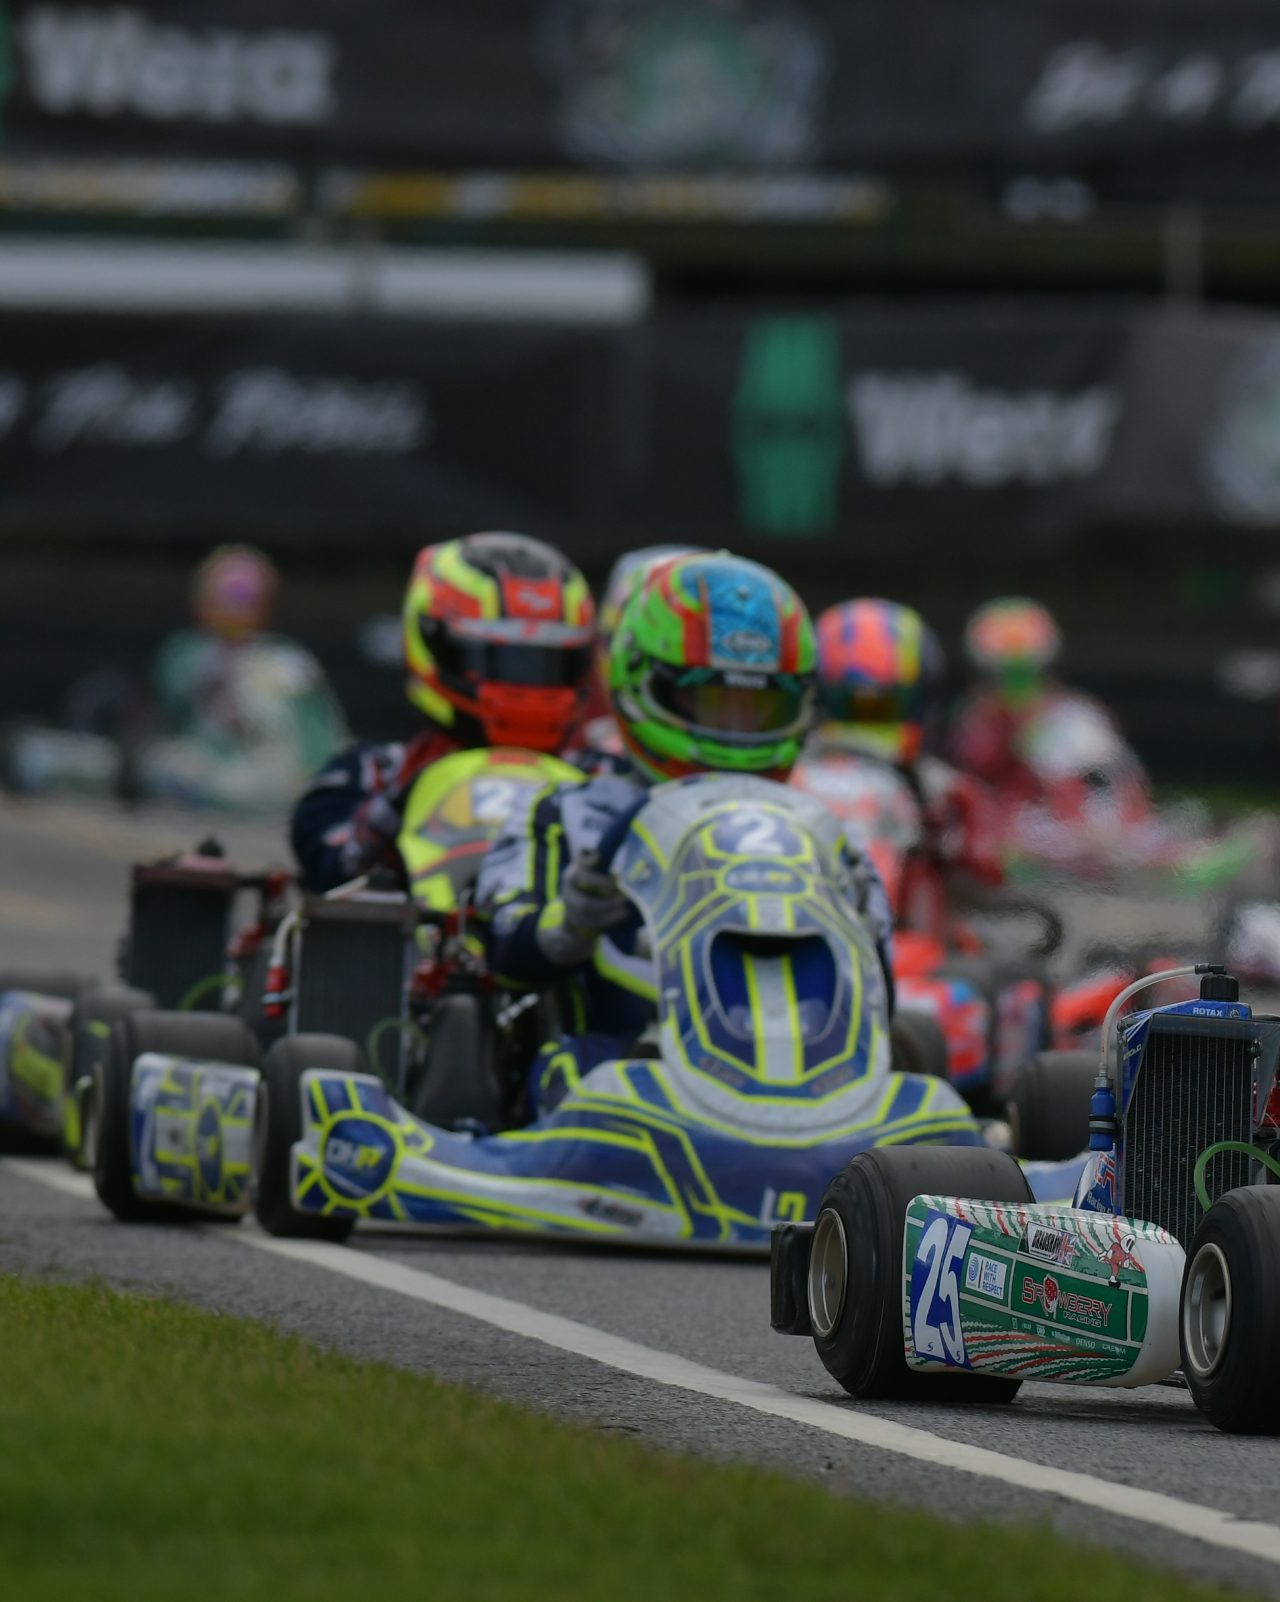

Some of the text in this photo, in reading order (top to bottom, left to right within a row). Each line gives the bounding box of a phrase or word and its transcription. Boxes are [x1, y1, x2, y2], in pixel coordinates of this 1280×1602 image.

[730, 814, 783, 857] 2
[1192, 1007, 1223, 1017] ROTAX
[986, 1261, 998, 1273] RACE
[984, 1271, 997, 1283] WITH
[914, 1217, 972, 1365] 25
[982, 1281, 1003, 1297] RESPECT
[1063, 1310, 1102, 1328] RACING
[1075, 1337, 1096, 1349] DENSO
